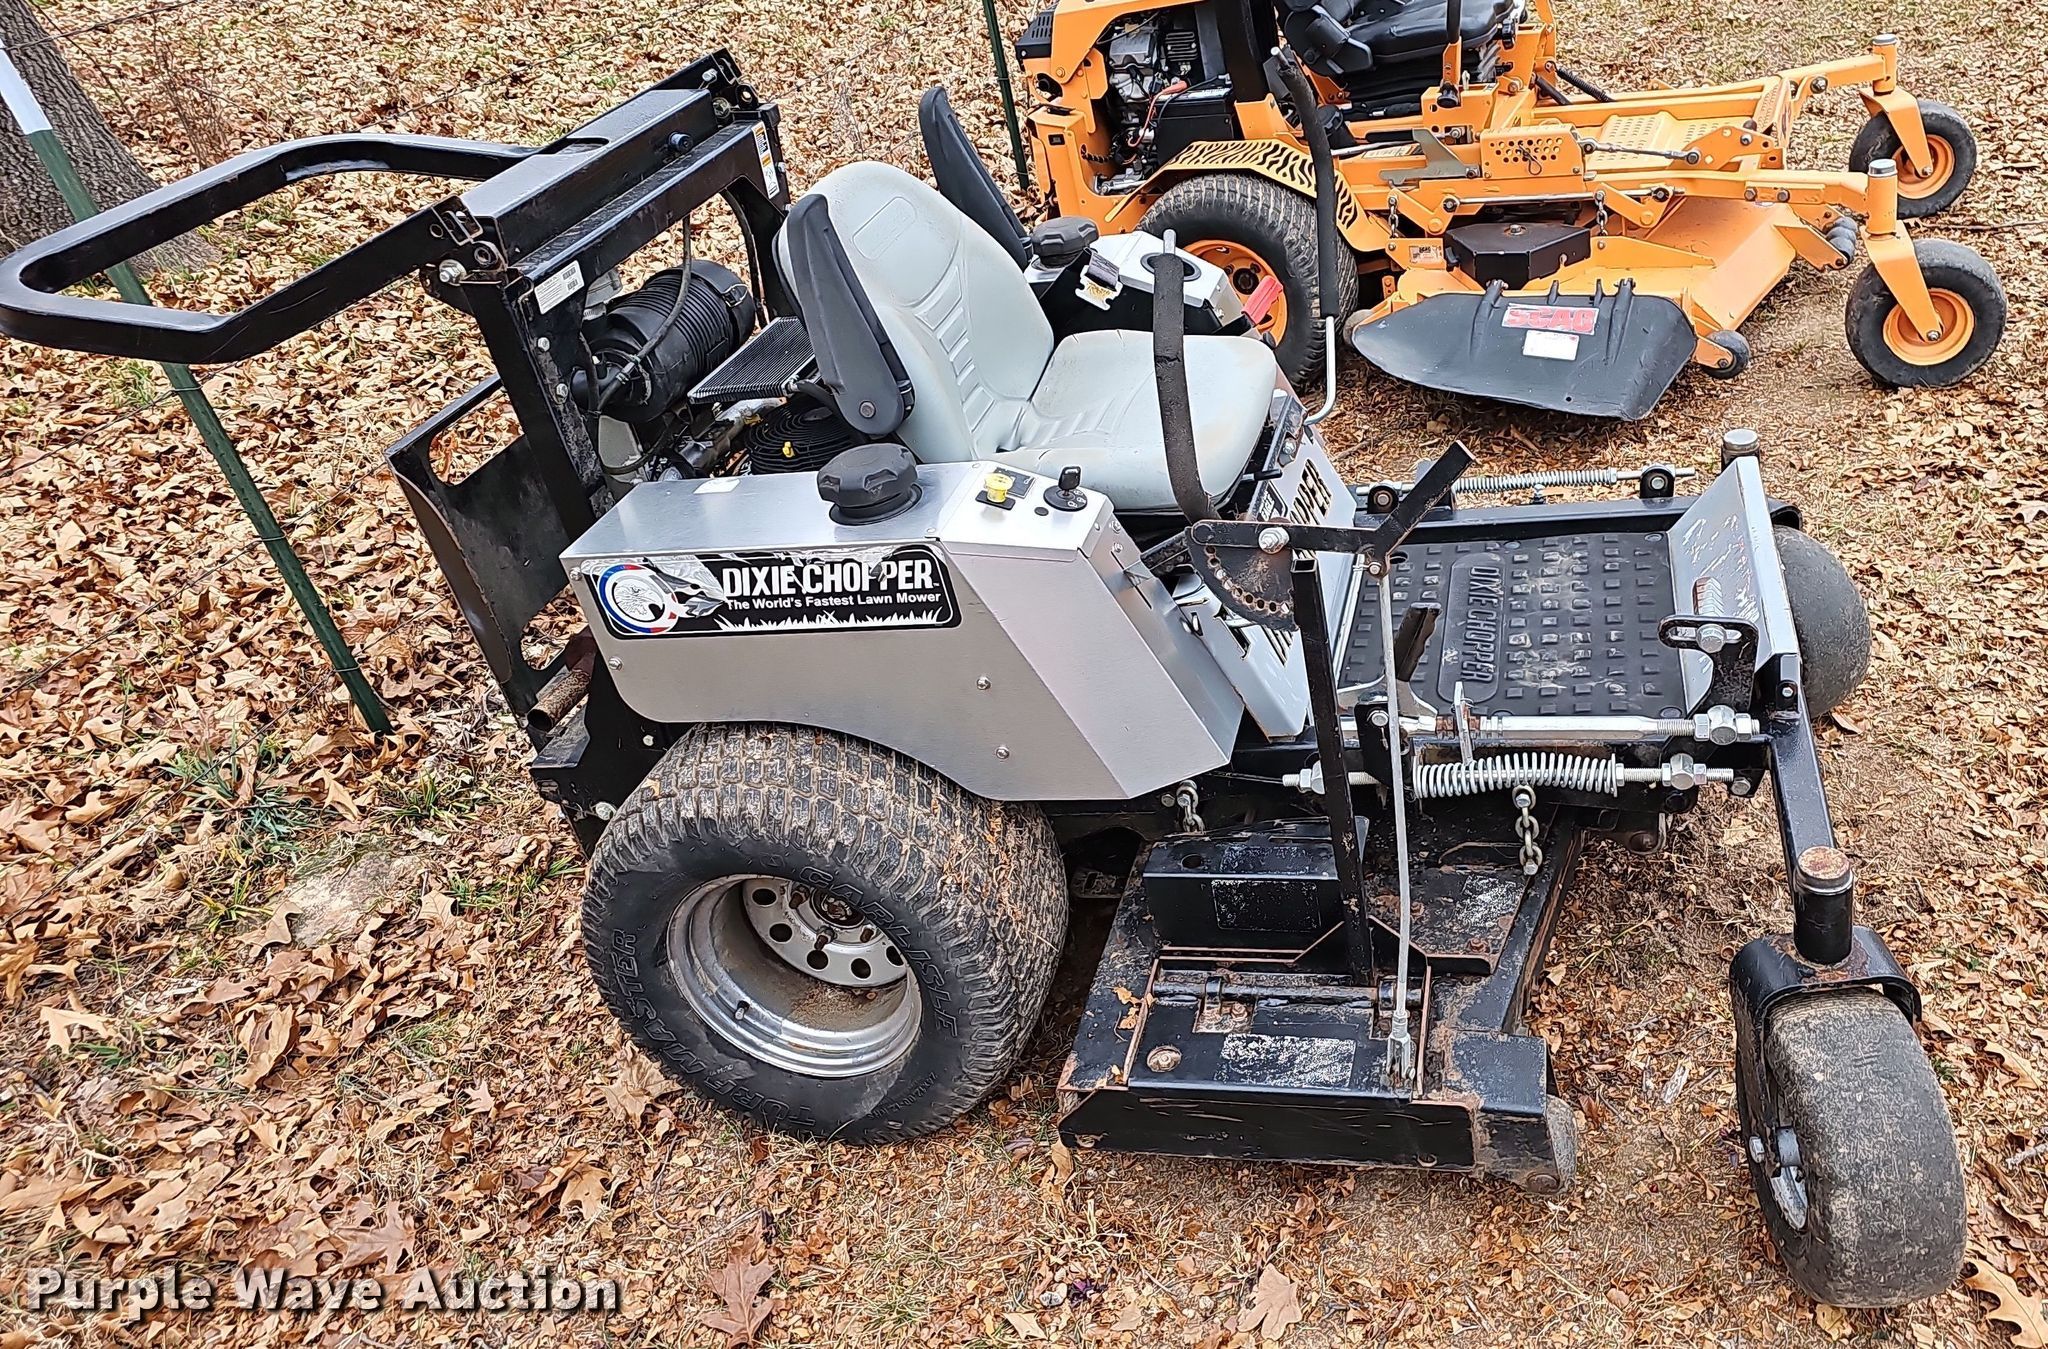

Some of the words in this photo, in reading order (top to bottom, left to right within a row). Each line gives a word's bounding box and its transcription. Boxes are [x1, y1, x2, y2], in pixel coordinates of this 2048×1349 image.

[1507, 307, 1596, 333] SCAG
[722, 565, 796, 598] DIXIE
[728, 599, 750, 610] The
[752, 597, 802, 609] World's
[806, 595, 855, 607] Fastest
[857, 594, 893, 605] Lawn
[897, 592, 941, 604] Mower
[1468, 566, 1504, 606] DIXIE
[1461, 608, 1498, 684] CHOPPER
[800, 866, 958, 1037] CARLISLE
[611, 929, 708, 1074] MASTER
